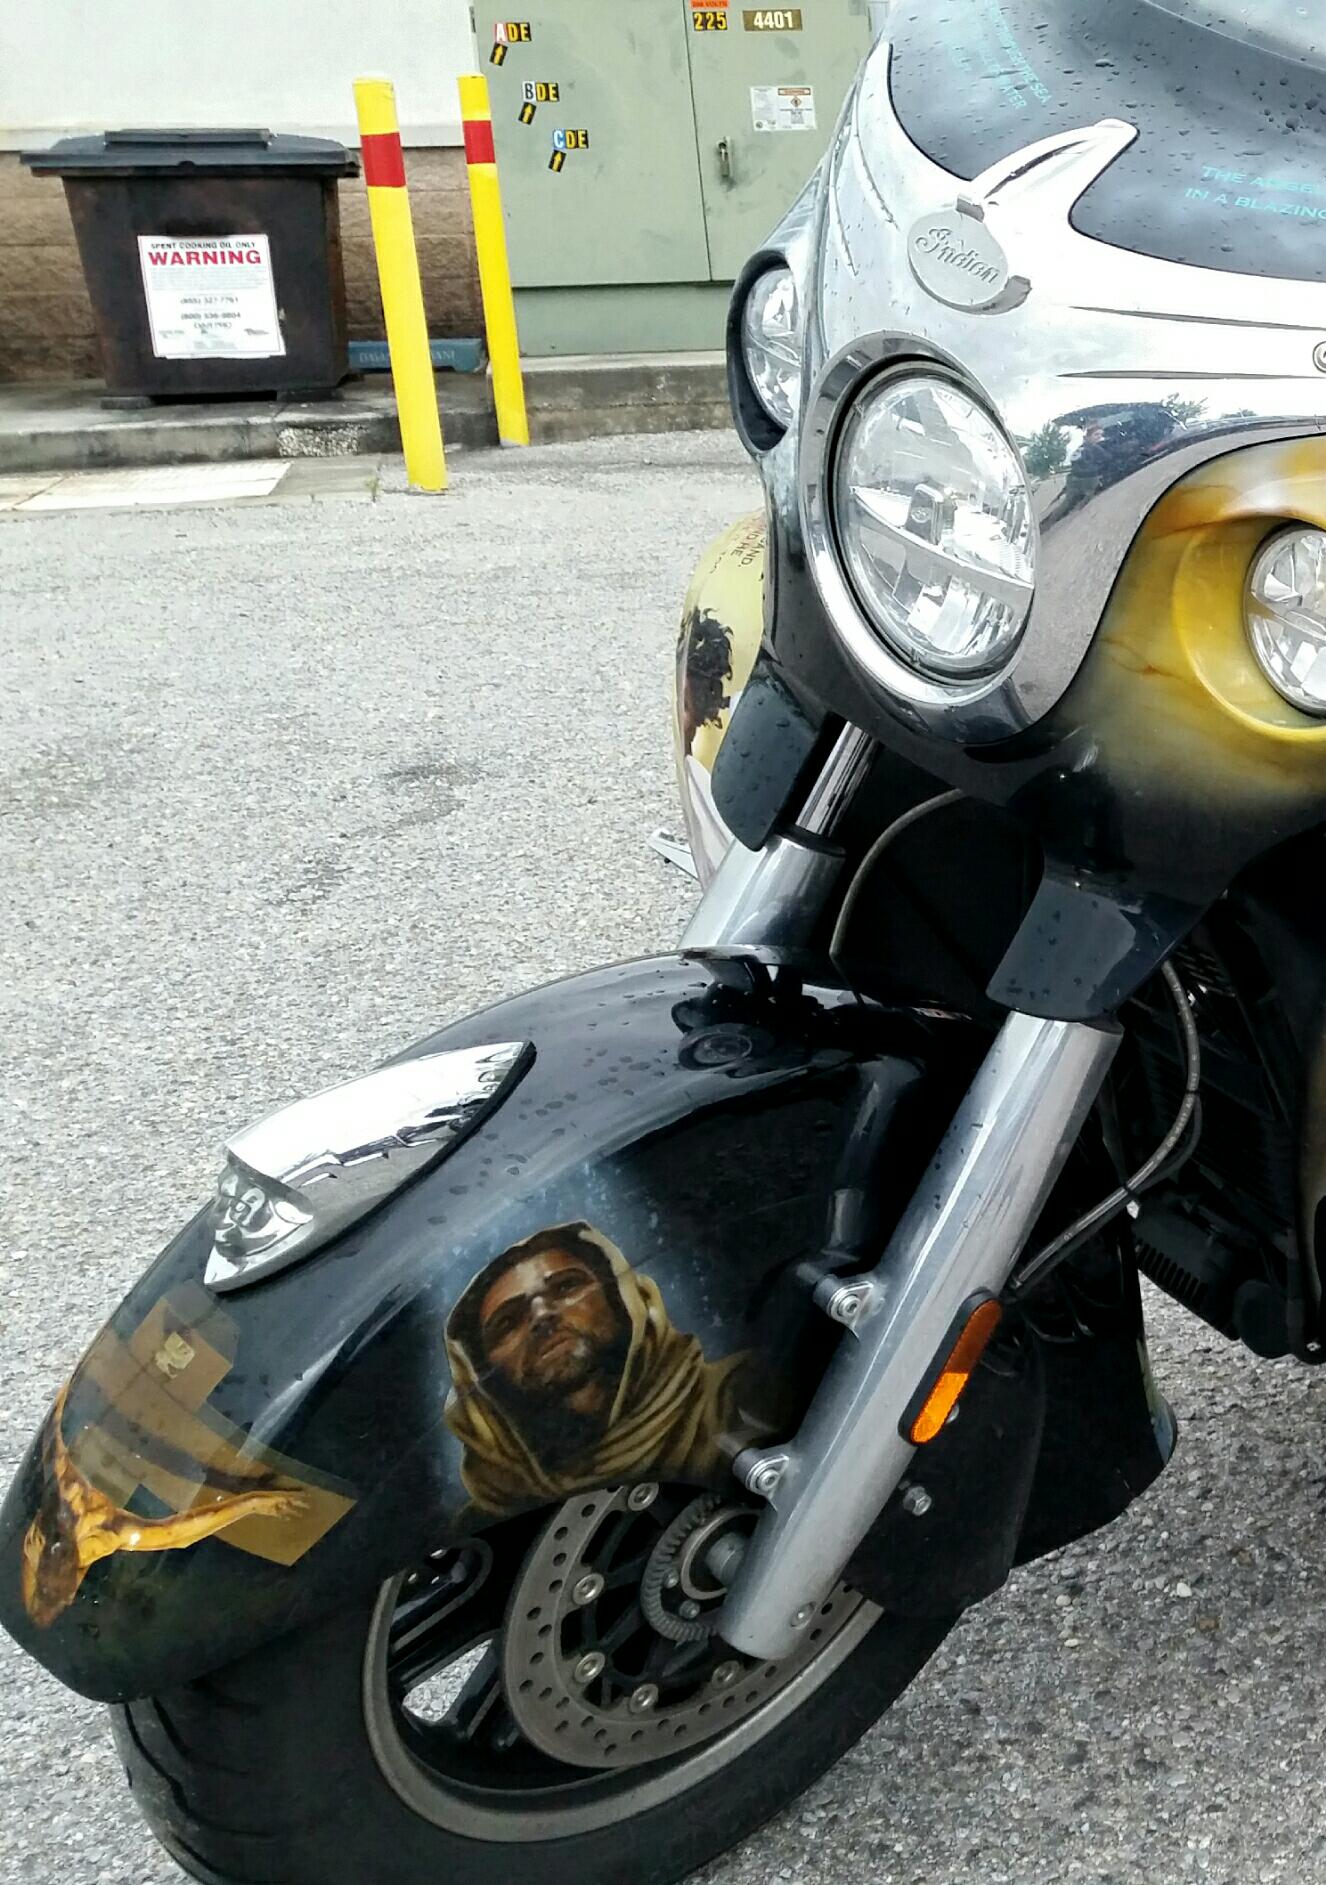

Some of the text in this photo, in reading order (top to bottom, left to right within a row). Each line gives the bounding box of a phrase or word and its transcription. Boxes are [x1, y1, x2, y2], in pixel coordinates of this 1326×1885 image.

[694, 12, 727, 30] 225
[753, 11, 793, 29] 4401
[1202, 166, 1246, 184] THE
[1184, 187, 1209, 200] IN
[1214, 193, 1228, 204] A
[179, 241, 217, 249] COOKING
[219, 240, 231, 248] OIL
[236, 240, 255, 248] ONLY
[148, 250, 261, 265] WARNING
[915, 227, 1000, 283] Indian
